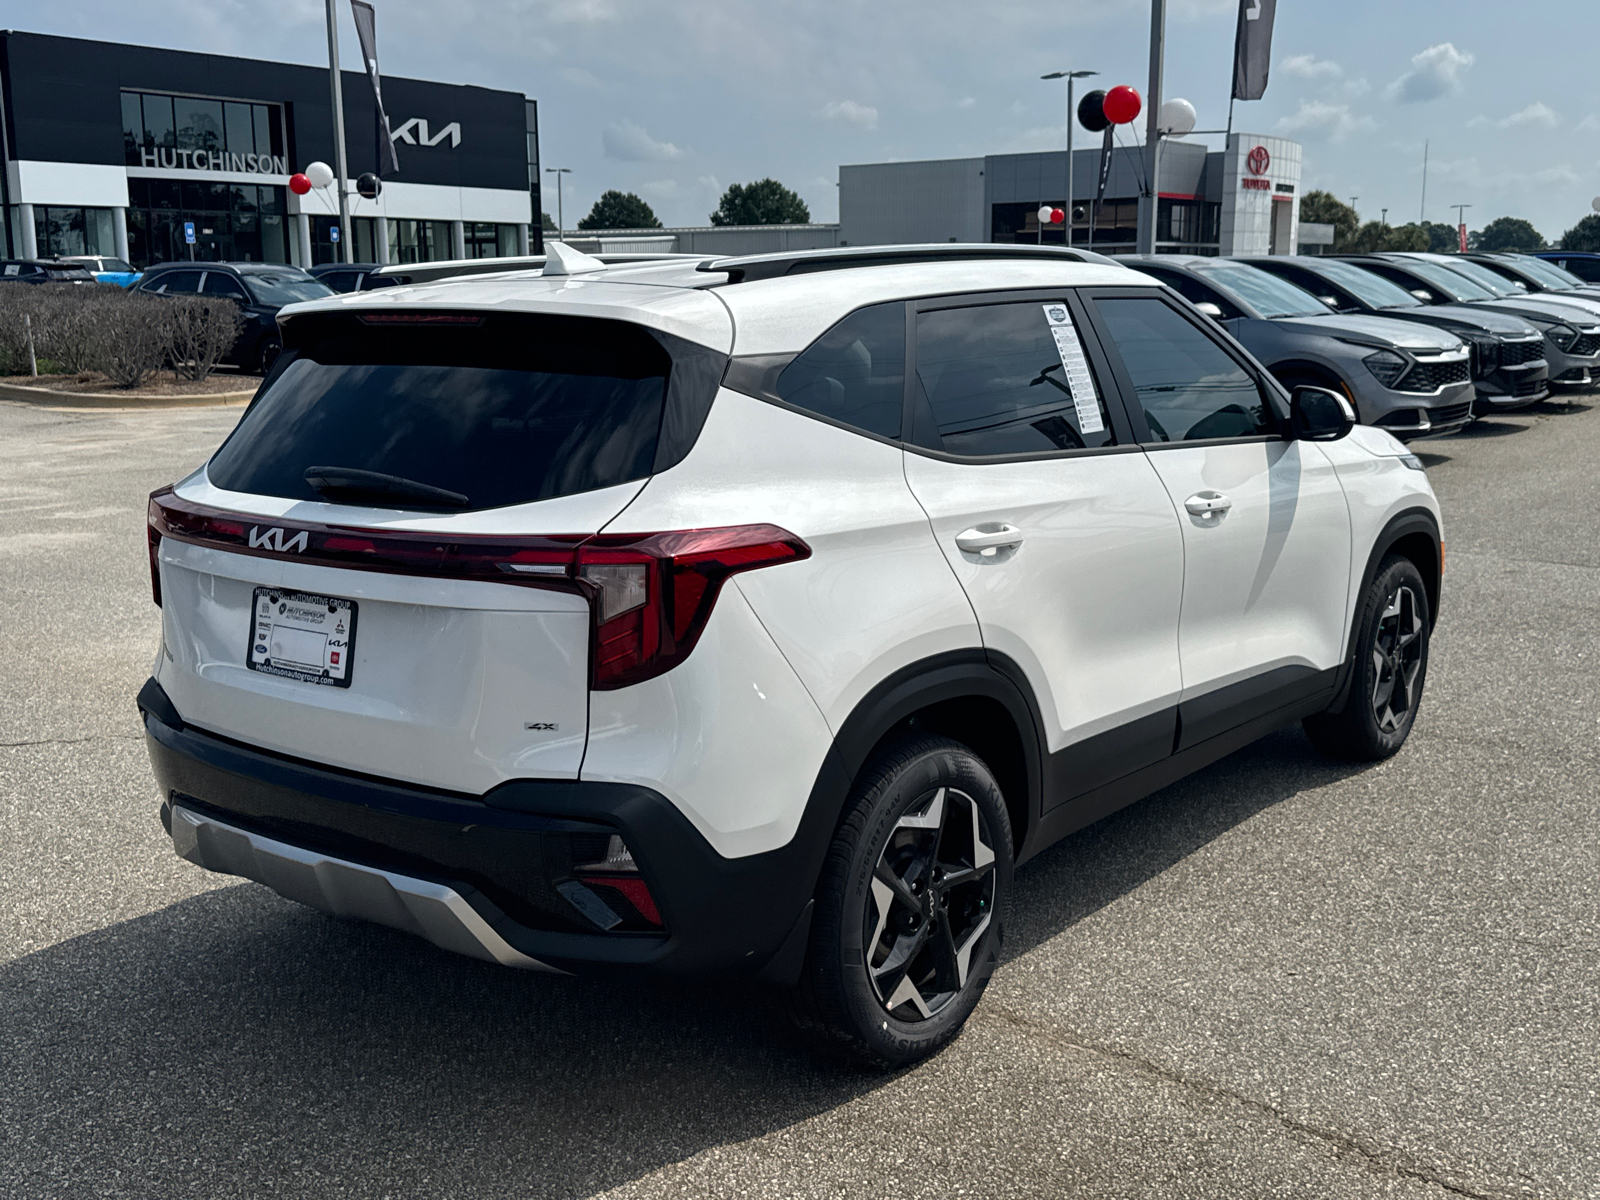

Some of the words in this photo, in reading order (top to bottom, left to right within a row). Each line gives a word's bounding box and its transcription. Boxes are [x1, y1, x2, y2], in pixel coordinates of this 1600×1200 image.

[384, 115, 462, 149] KIA
[141, 146, 287, 176] HUTCHINSON
[1242, 178, 1271, 190] TOYOTA
[248, 524, 309, 554] KIA
[329, 598, 351, 610] GROUP
[328, 639, 348, 648] KIA
[255, 663, 334, 685] Hutchinsonautogroup.com
